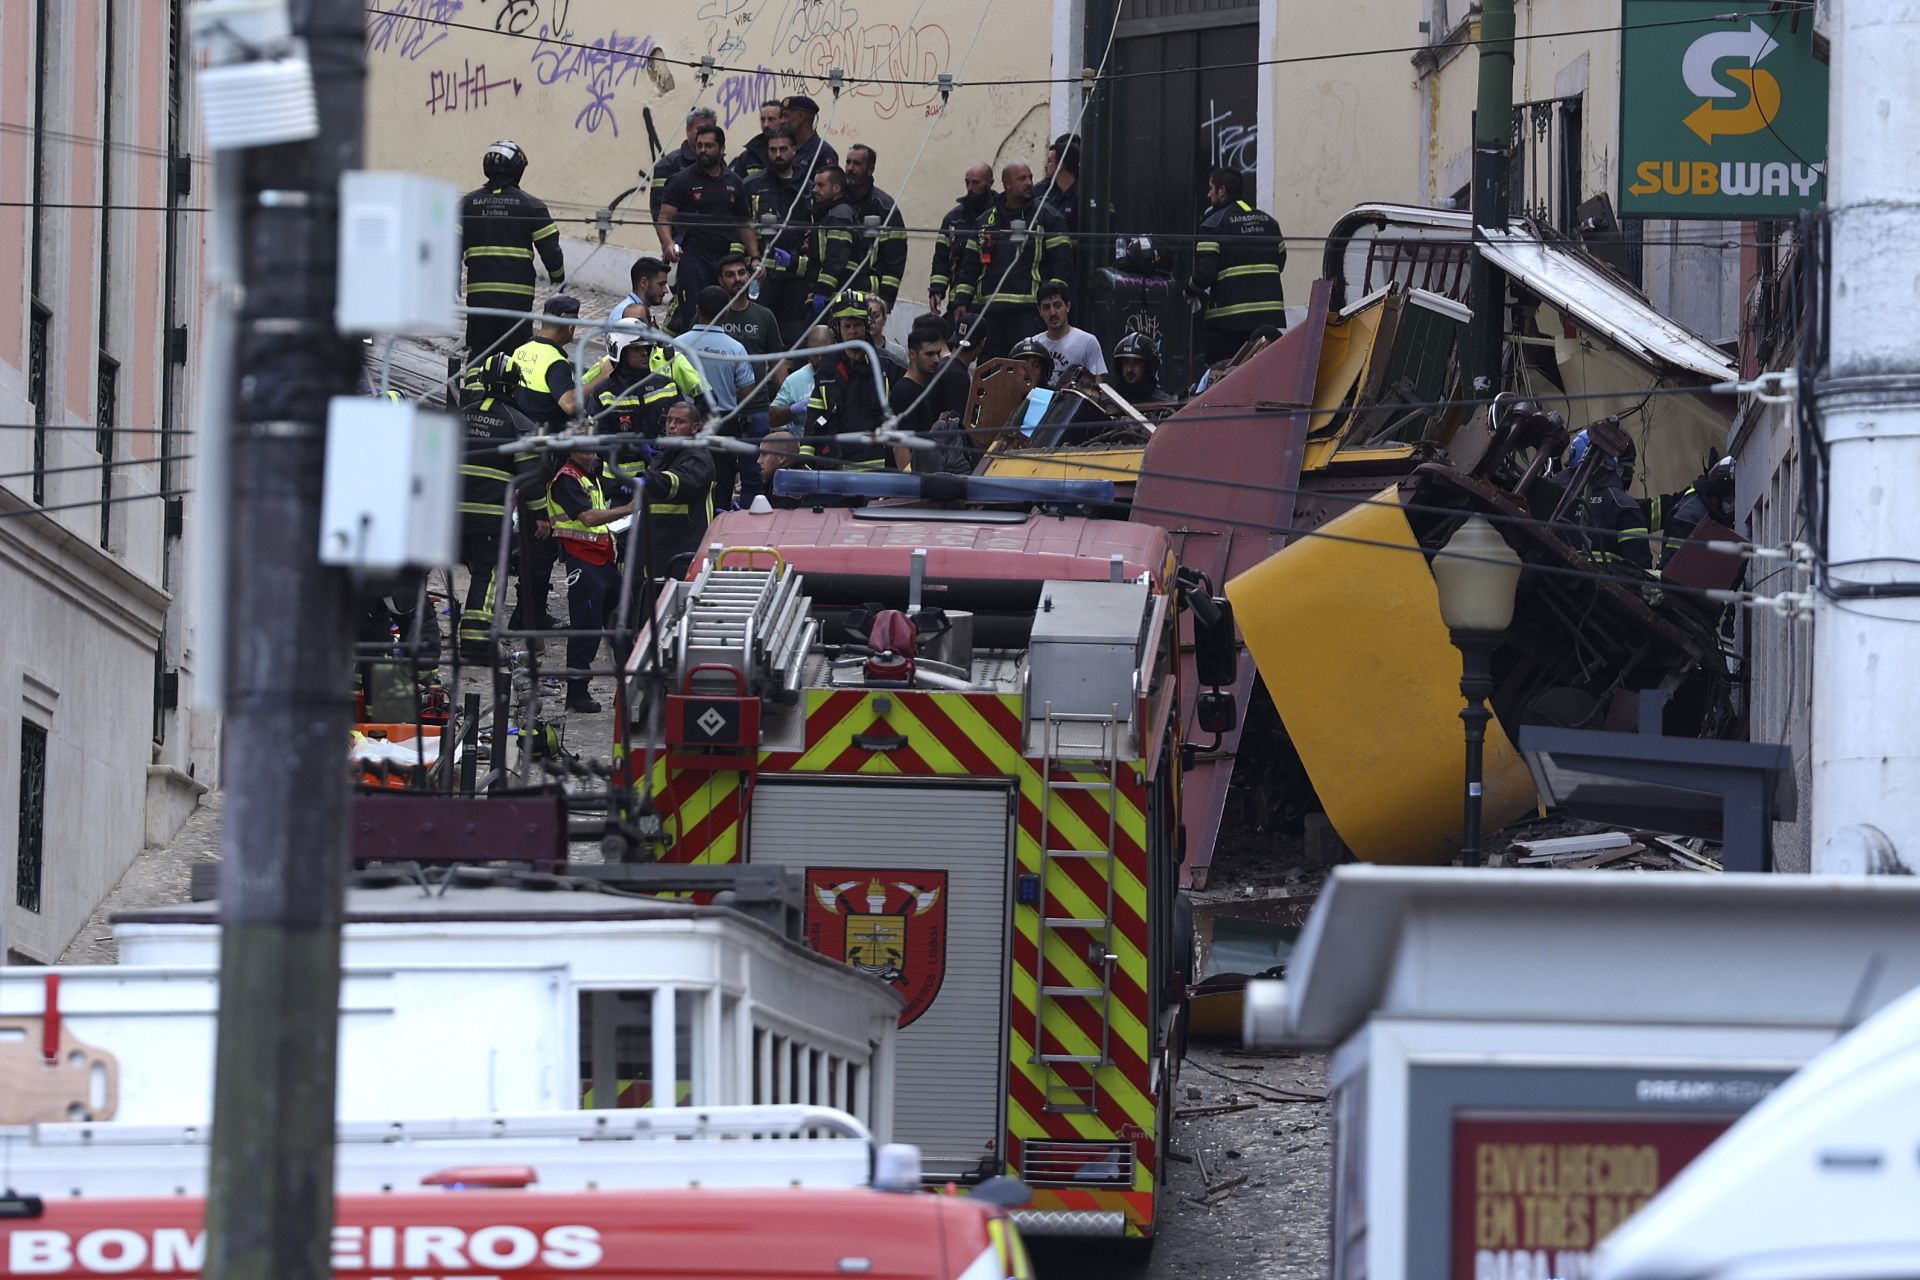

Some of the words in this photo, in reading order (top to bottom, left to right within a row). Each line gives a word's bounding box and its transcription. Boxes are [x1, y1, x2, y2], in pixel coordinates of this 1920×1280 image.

[1628, 160, 1829, 197] SUBWAY
[744, 323, 759, 334] OF
[984, 1139, 994, 1150] 4
[1475, 1144, 1659, 1194] ENVELHECIDO
[1475, 1198, 1517, 1248] EM
[9, 1225, 604, 1273] BOMEIROS
